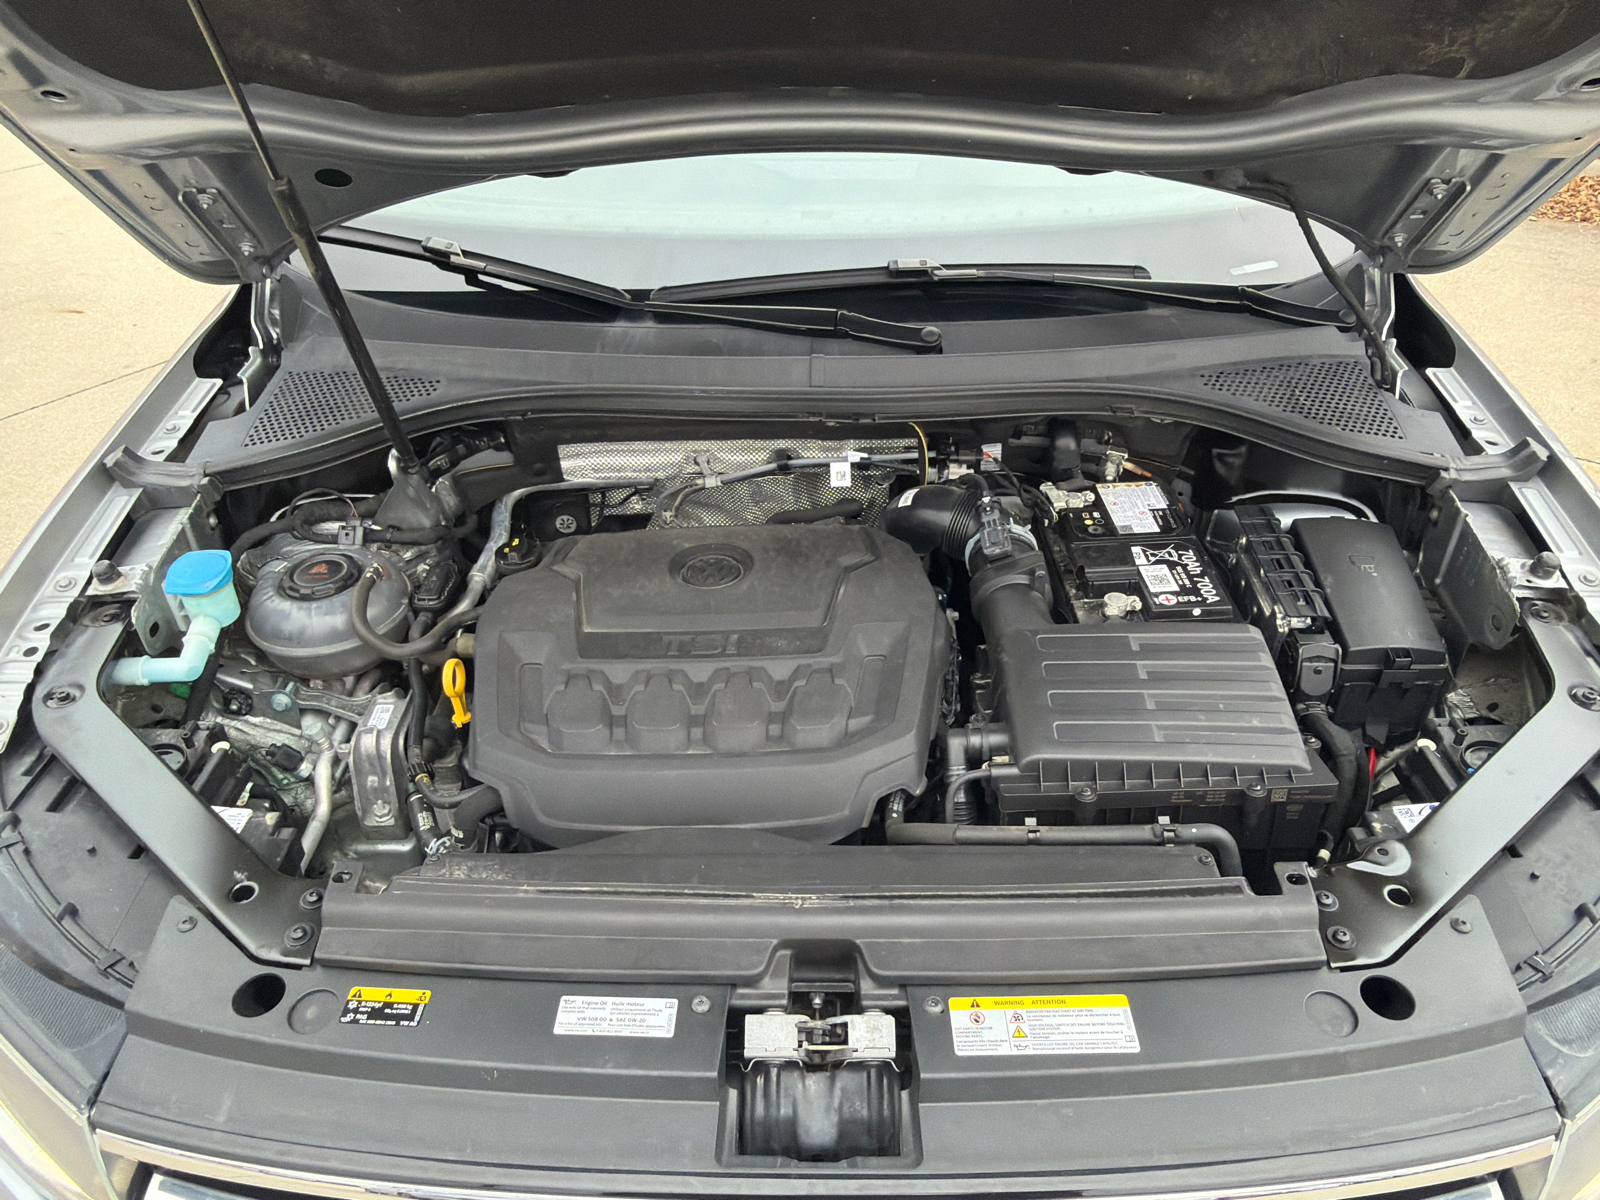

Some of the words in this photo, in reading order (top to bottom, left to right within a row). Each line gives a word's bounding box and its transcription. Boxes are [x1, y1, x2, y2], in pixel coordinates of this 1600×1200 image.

[1178, 549, 1203, 575] 70Ah
[1193, 576, 1220, 604] 700A
[662, 634, 740, 655] TSI
